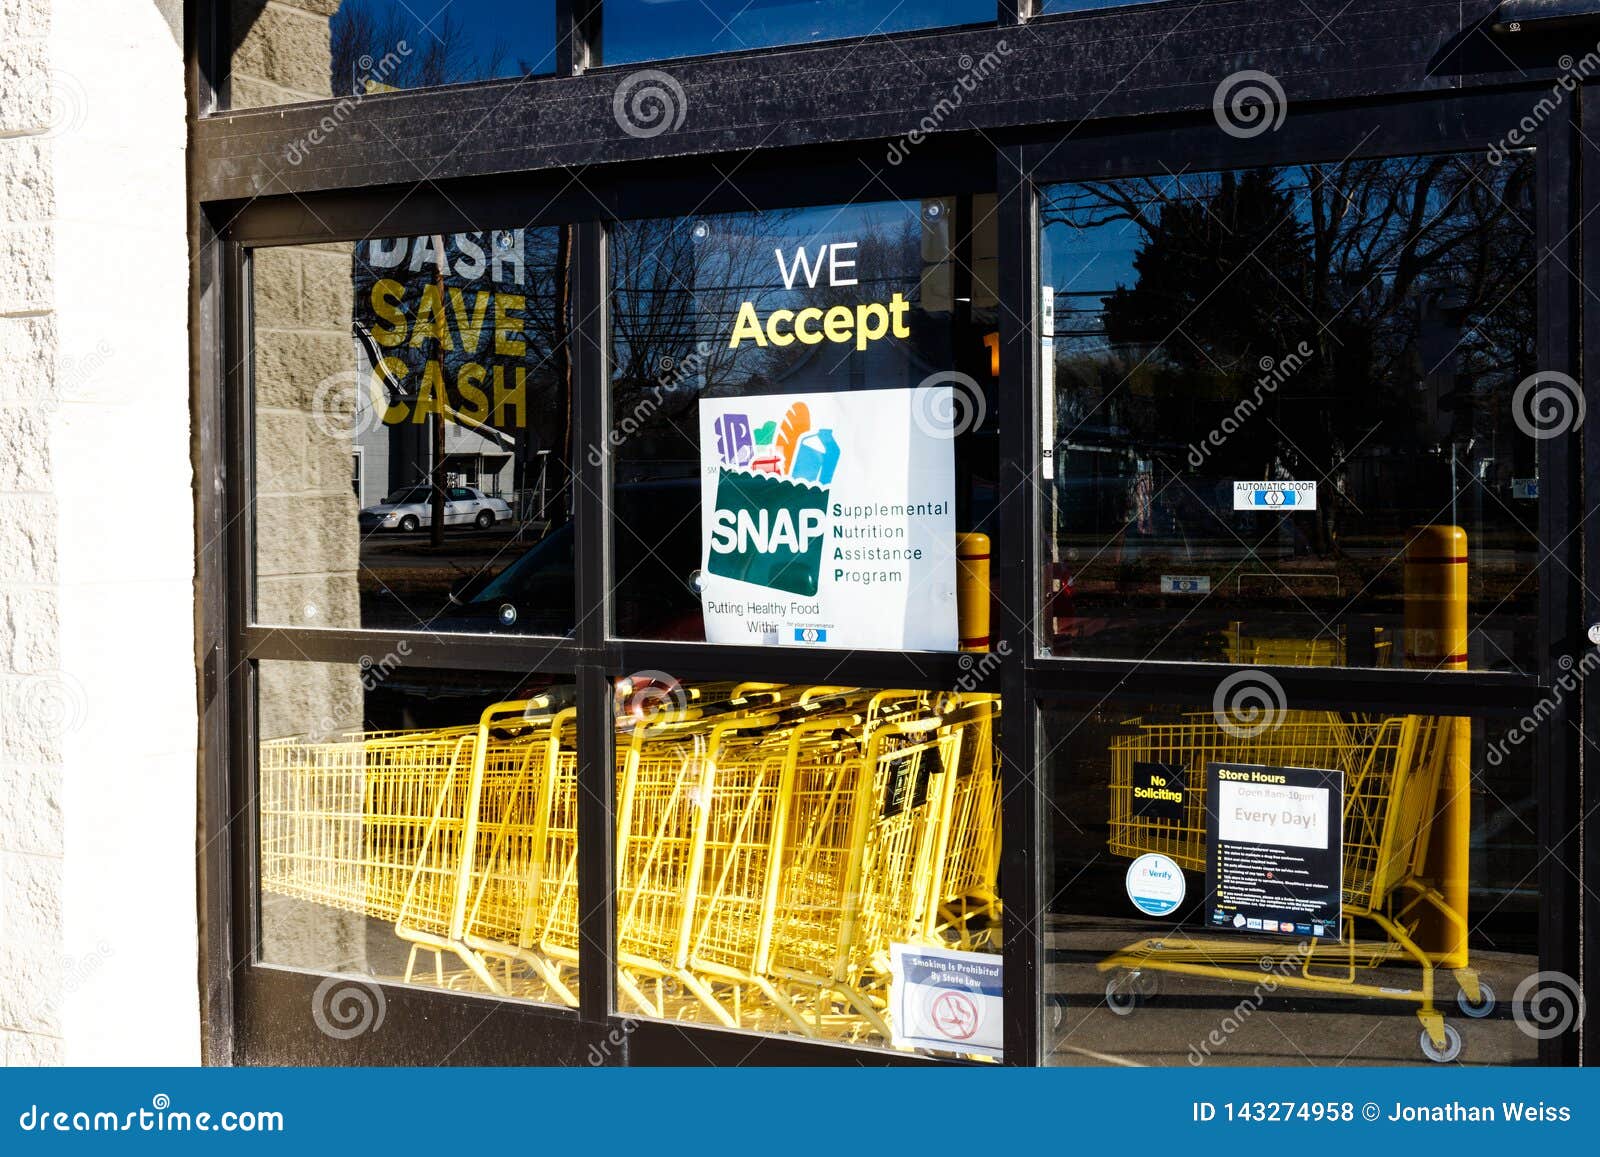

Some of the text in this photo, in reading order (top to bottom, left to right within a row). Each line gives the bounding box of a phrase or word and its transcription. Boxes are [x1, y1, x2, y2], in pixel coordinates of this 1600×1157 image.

[775, 242, 858, 290] WE
[371, 279, 526, 357] SAVE
[728, 293, 910, 351] Accept
[370, 357, 526, 428] CASH
[1237, 483, 1314, 491] AUTOMATIC DOOR
[833, 501, 949, 519] Supplemental
[711, 508, 827, 555] SNAP
[833, 525, 904, 539] Nutrition
[834, 547, 923, 561] Assistance
[835, 569, 902, 585] Program
[708, 601, 820, 618] Putting Healthy Food
[1150, 775, 1167, 787] No
[1218, 769, 1286, 784] Store Hours
[1134, 787, 1183, 803] Soliciting
[1235, 807, 1317, 829] Every Day!
[912, 958, 999, 977] Smoking Is Prohibited
[931, 971, 981, 987] By State Law
